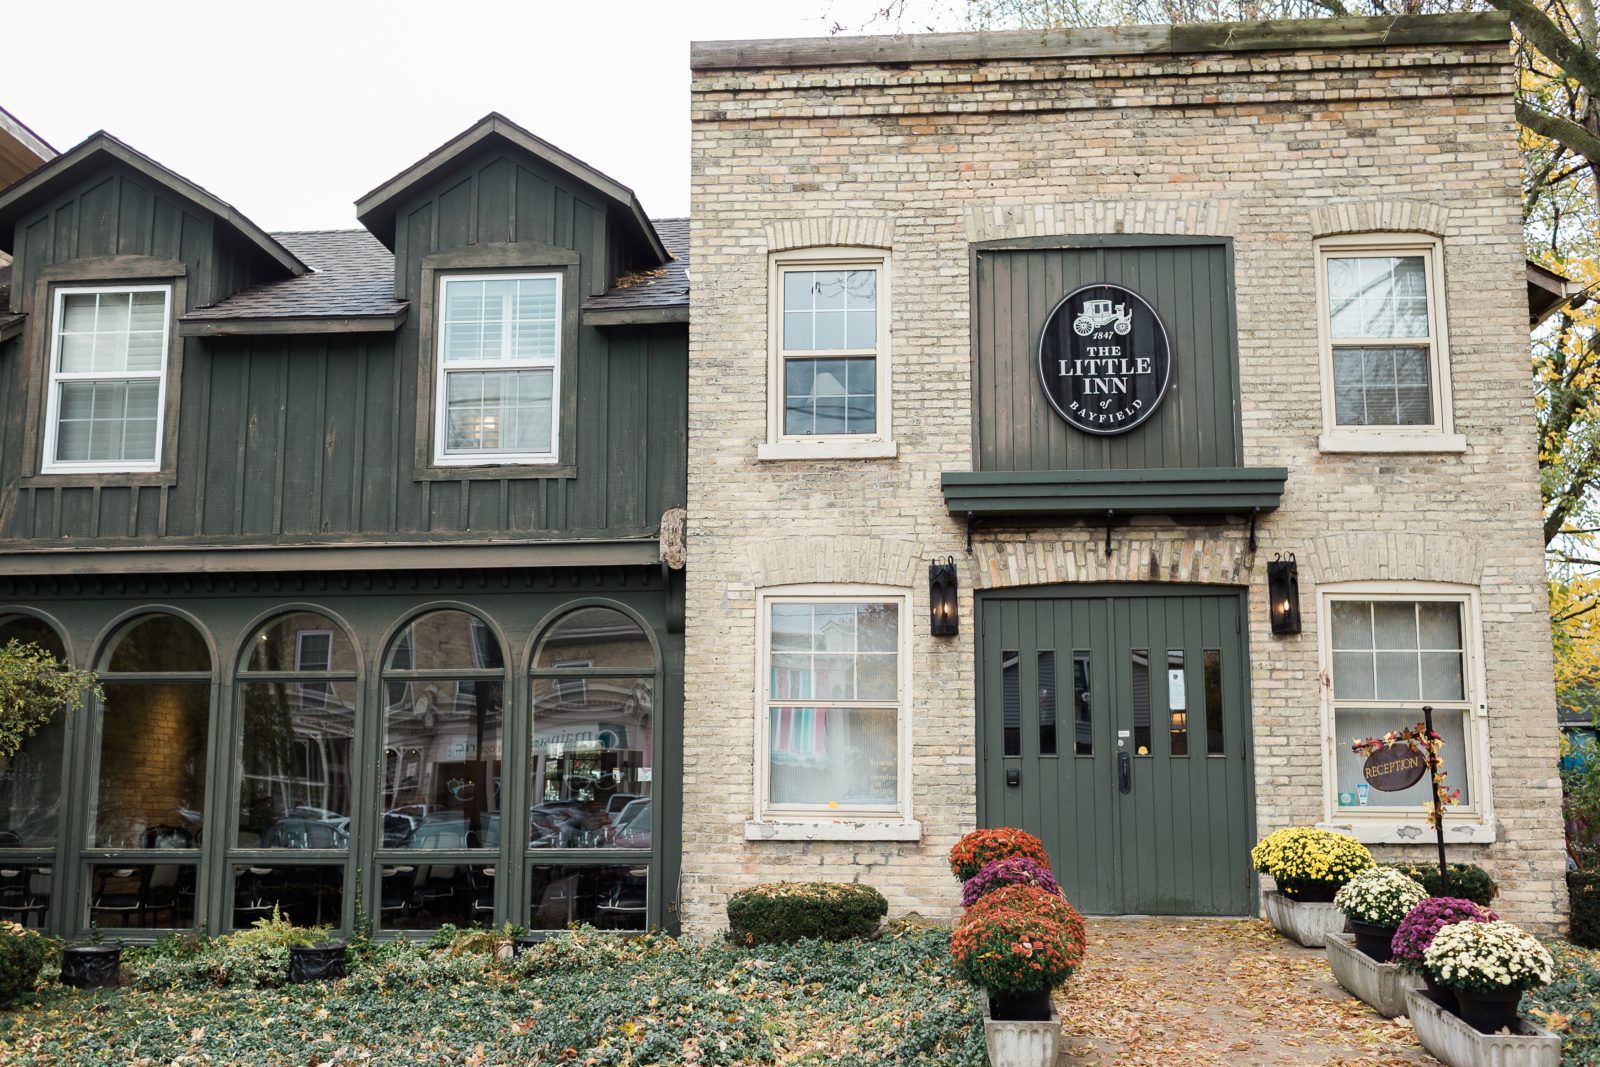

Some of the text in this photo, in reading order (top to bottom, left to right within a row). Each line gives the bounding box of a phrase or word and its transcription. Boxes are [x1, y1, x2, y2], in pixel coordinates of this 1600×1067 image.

[1092, 331, 1114, 340] 1847
[1086, 346, 1121, 357] THE
[1058, 357, 1152, 376] LITTLE
[1083, 377, 1129, 395] INN
[1069, 399, 1143, 423] BAYFIELD
[1099, 399, 1112, 409] of
[1365, 757, 1419, 779] RECEPTION
